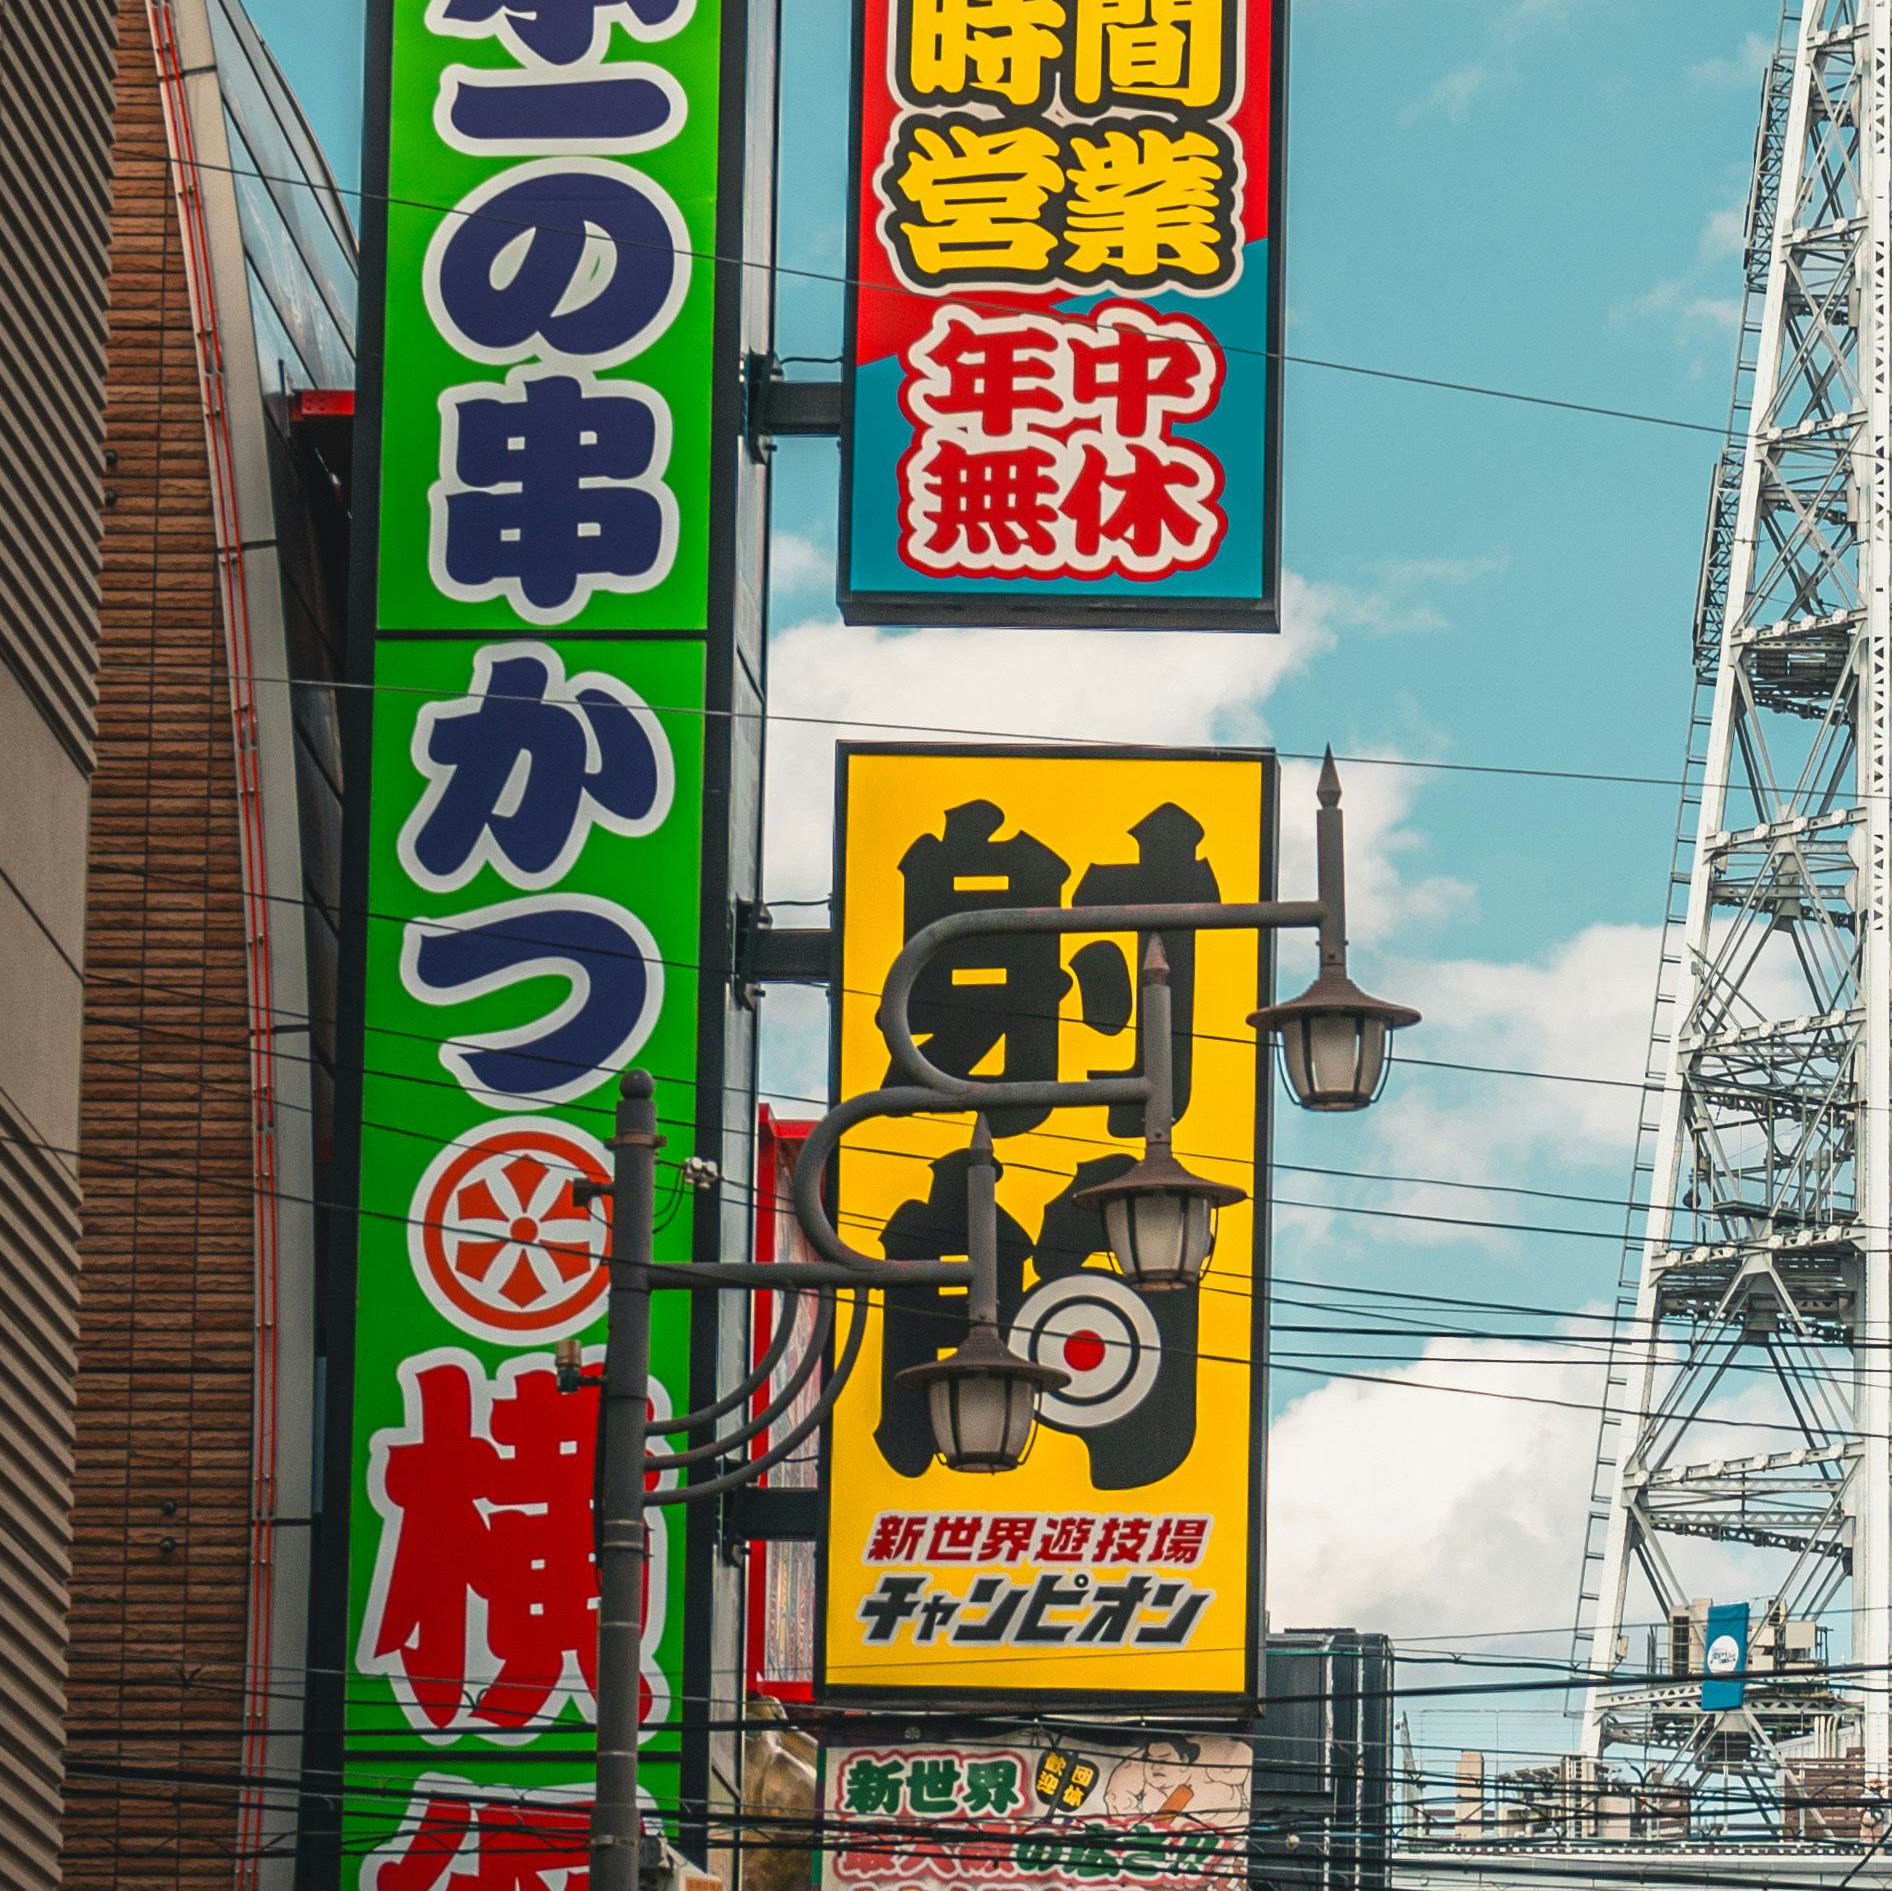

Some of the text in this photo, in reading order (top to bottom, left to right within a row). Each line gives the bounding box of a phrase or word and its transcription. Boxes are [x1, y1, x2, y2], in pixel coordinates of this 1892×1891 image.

[890, 120, 1232, 286] 営業
[908, 308, 1218, 440] 年中
[910, 438, 1218, 563] 無休
[866, 1510, 1211, 1566] 新世界遊技場
[858, 1571, 1214, 1647] チャンピオン
[843, 1756, 1023, 1814] 新世界
